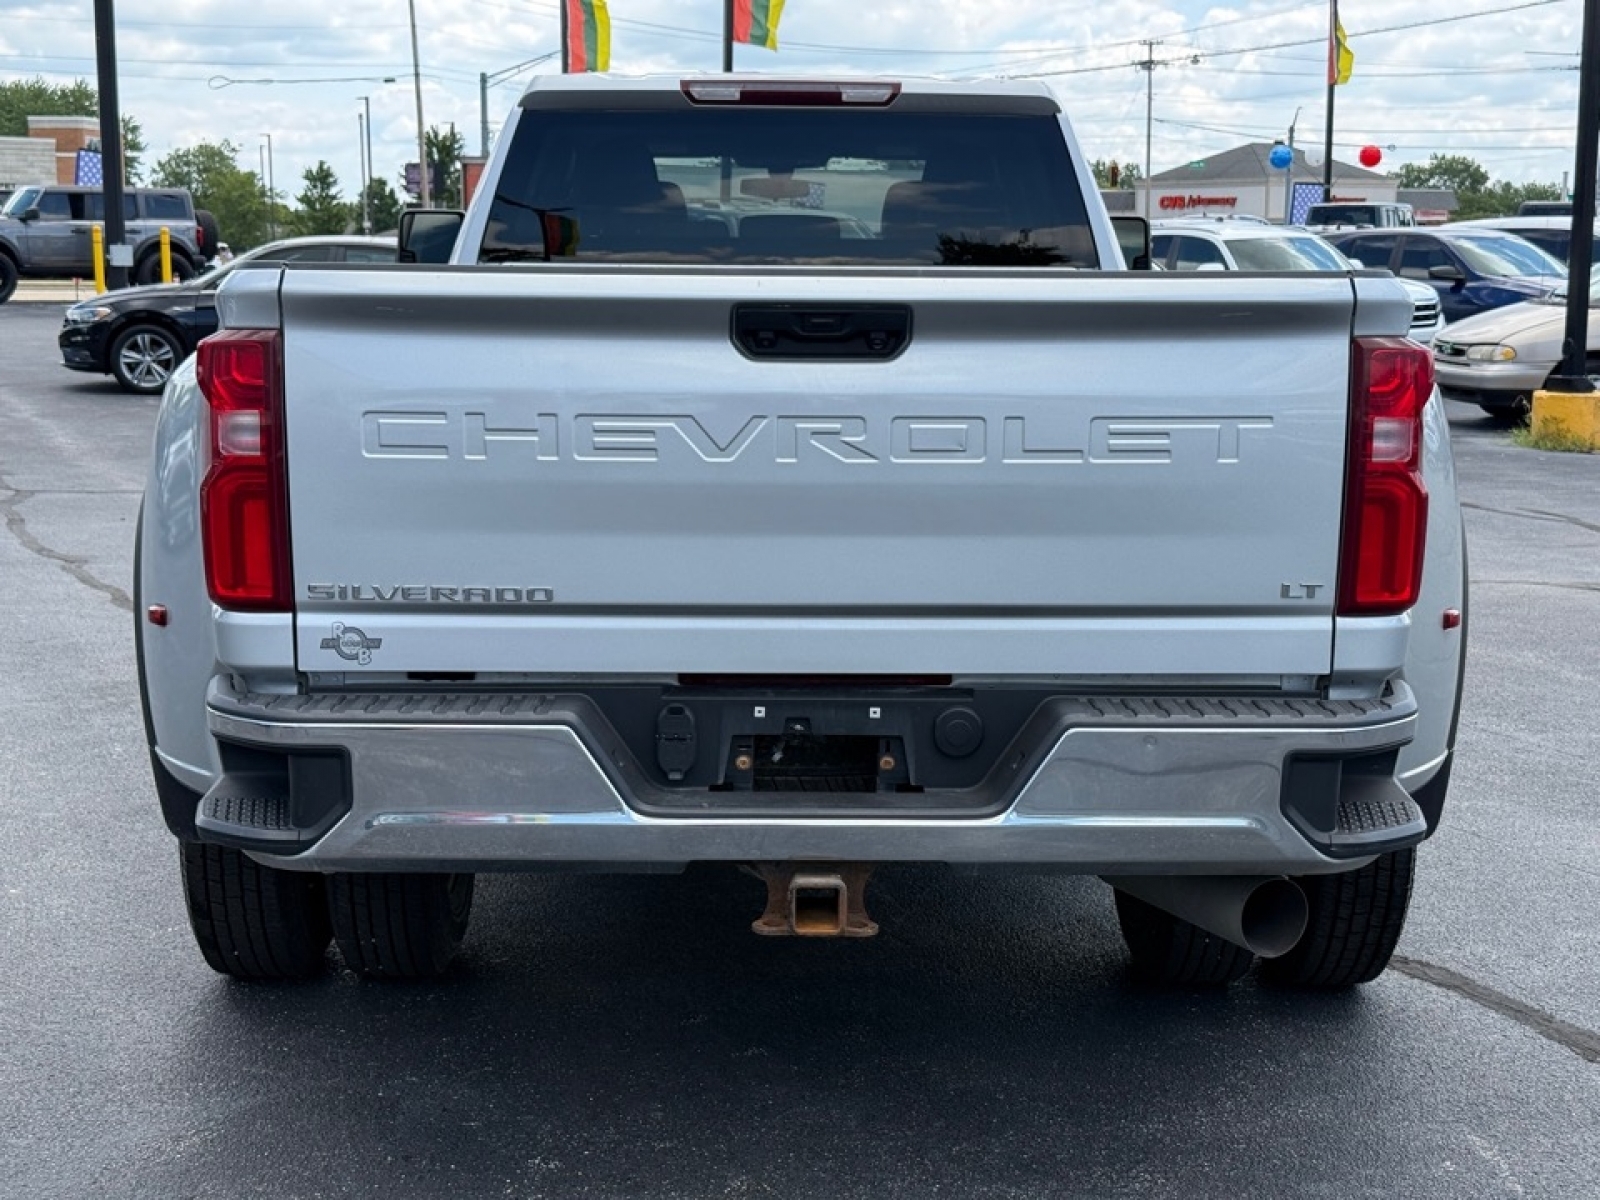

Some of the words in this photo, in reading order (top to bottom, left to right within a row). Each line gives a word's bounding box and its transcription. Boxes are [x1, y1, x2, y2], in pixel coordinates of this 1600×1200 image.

[361, 410, 1274, 464] CHEVROLET
[307, 583, 554, 602] SILVERADO
[1281, 582, 1325, 599] LT
